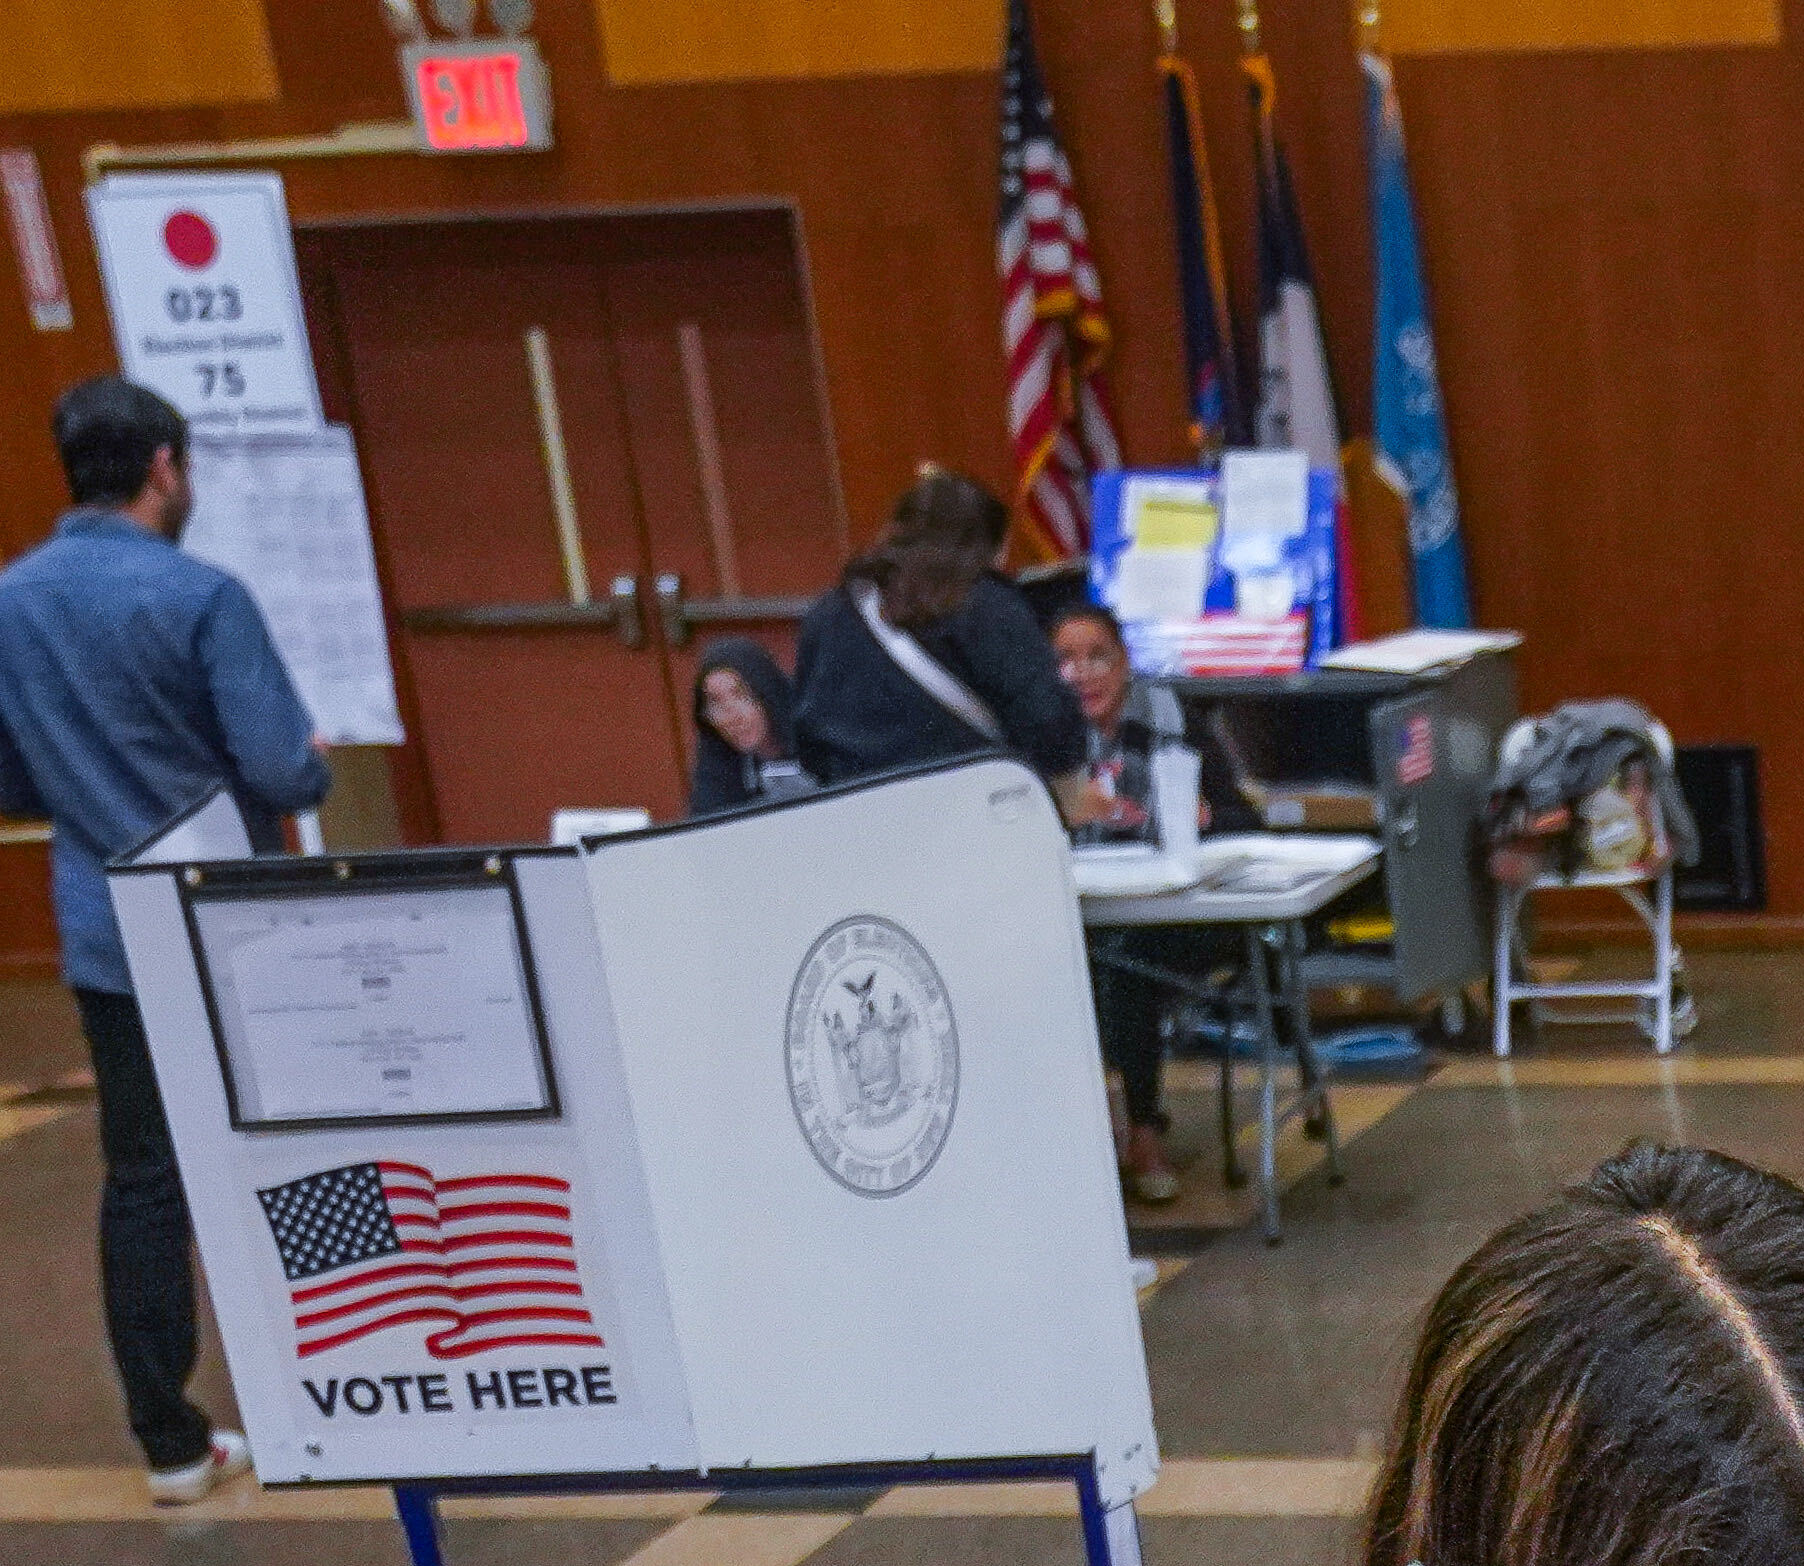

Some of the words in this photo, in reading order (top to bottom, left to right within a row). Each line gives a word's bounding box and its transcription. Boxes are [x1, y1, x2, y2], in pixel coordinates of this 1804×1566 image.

[418, 56, 527, 148] EXIT
[166, 285, 244, 322] 023
[195, 362, 246, 397] 75
[302, 1373, 453, 1417] VOTE
[466, 1365, 617, 1410] HERE
